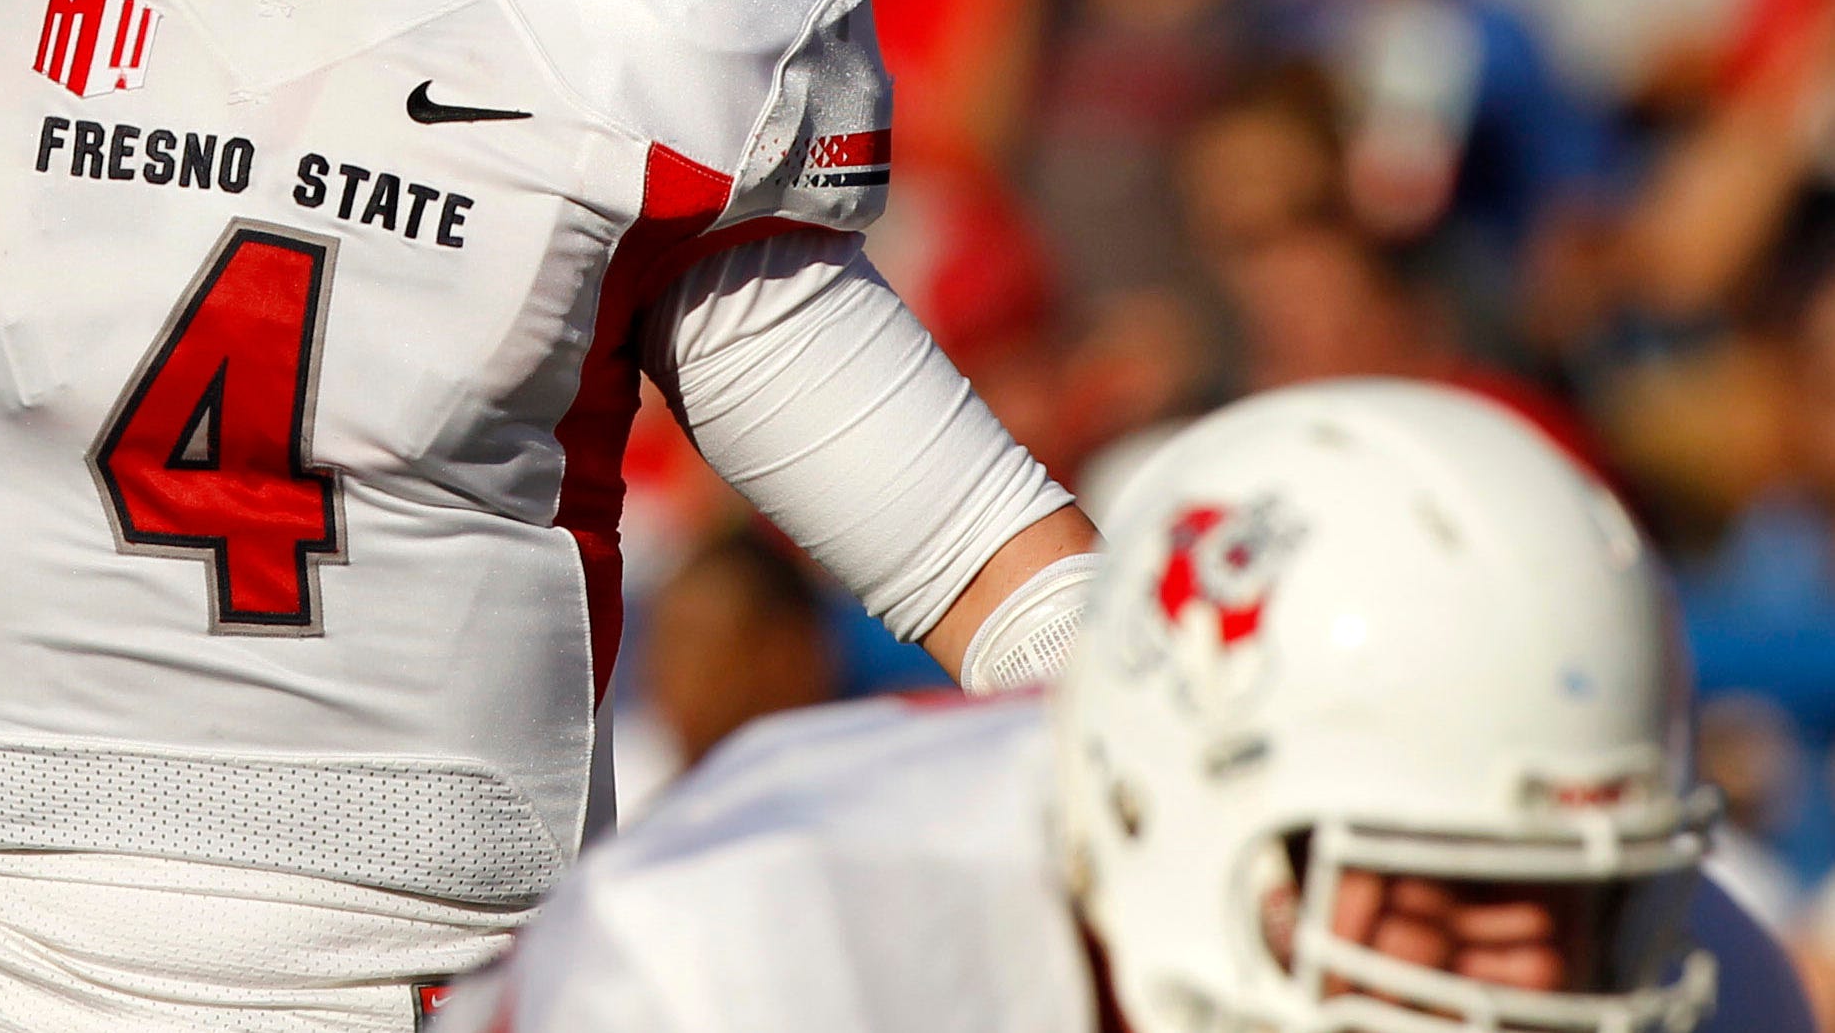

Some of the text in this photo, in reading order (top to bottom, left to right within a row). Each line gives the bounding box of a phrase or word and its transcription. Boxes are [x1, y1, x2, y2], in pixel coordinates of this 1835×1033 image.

[35, 116, 475, 249] FRESNO STATE
[84, 216, 350, 638] 4
